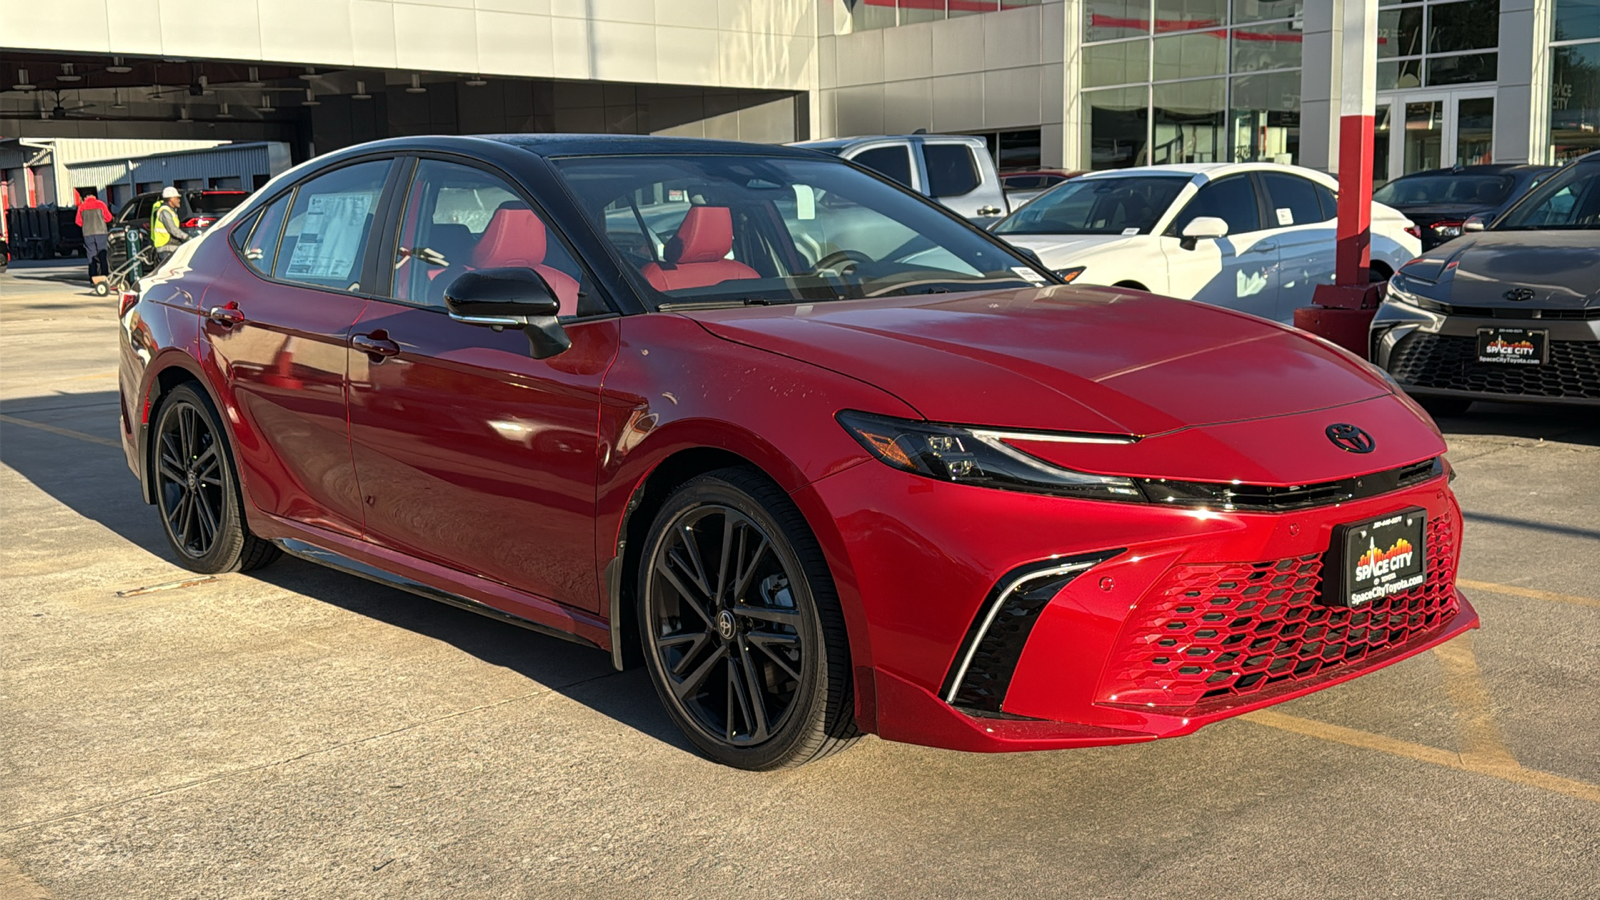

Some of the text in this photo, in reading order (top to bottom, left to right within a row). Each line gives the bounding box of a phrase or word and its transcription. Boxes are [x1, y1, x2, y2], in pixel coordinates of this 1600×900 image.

[1479, 355, 1540, 365] SpaceCityToyota.com
[1486, 345, 1535, 356] SPACE CITY
[1355, 551, 1413, 582] SPACE CITY
[1351, 575, 1423, 605] SpaceCityToyota.com
